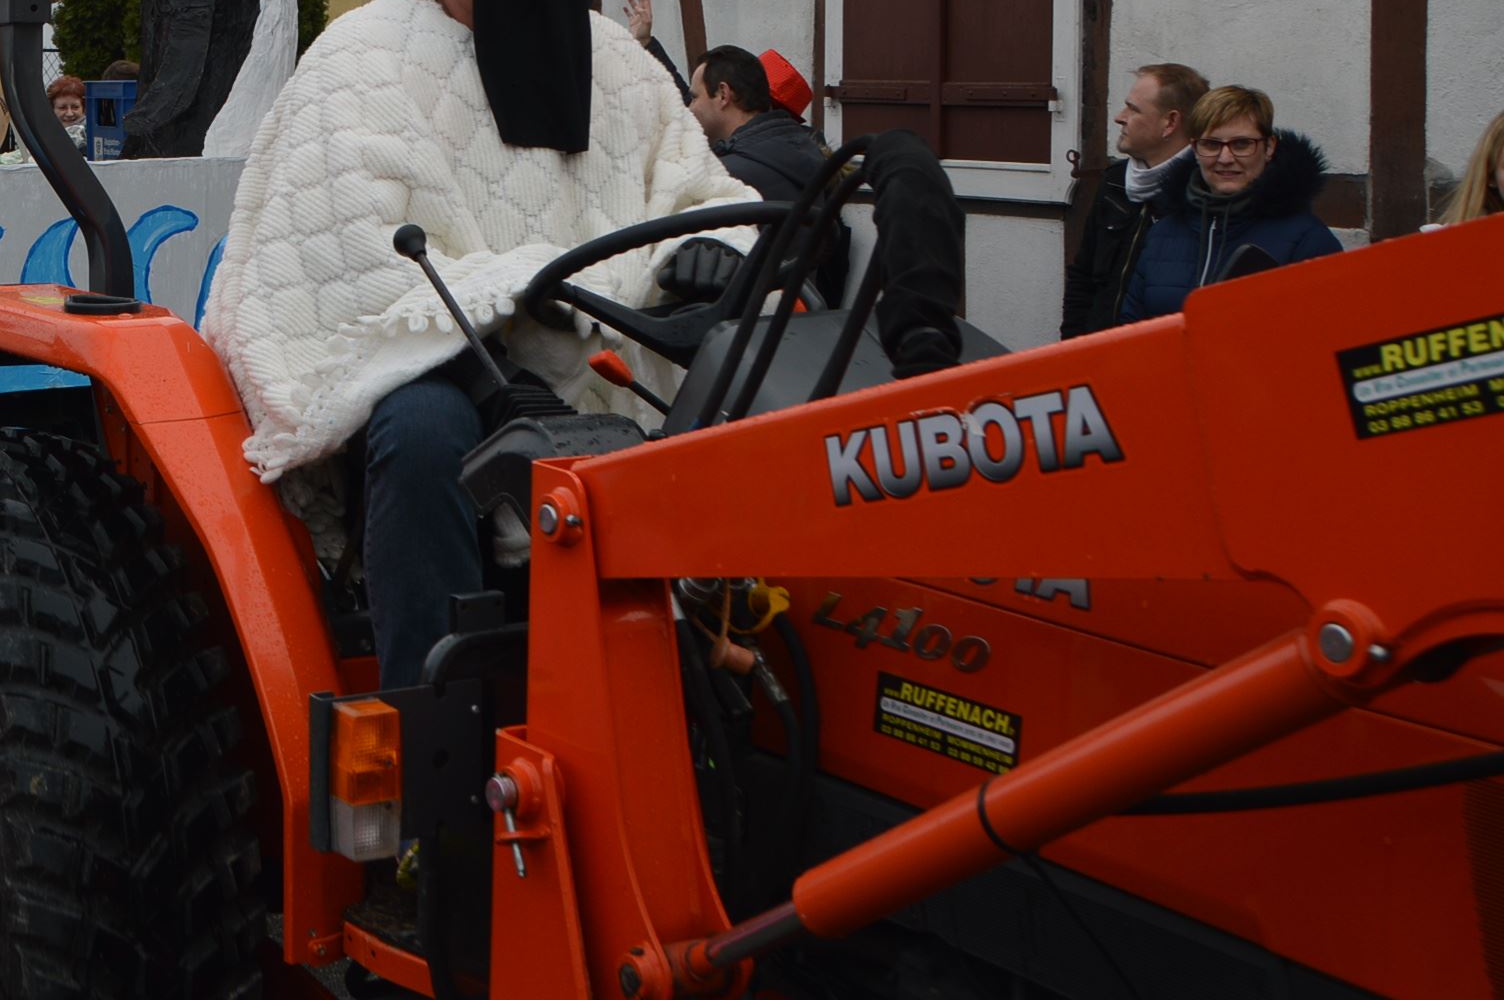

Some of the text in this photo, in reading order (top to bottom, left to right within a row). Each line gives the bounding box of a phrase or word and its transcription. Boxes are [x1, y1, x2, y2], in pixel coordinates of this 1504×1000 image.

[1364, 383, 1480, 416] ROPPENHEIM
[824, 382, 1126, 508] KUBOTA
[812, 590, 992, 673] L4100
